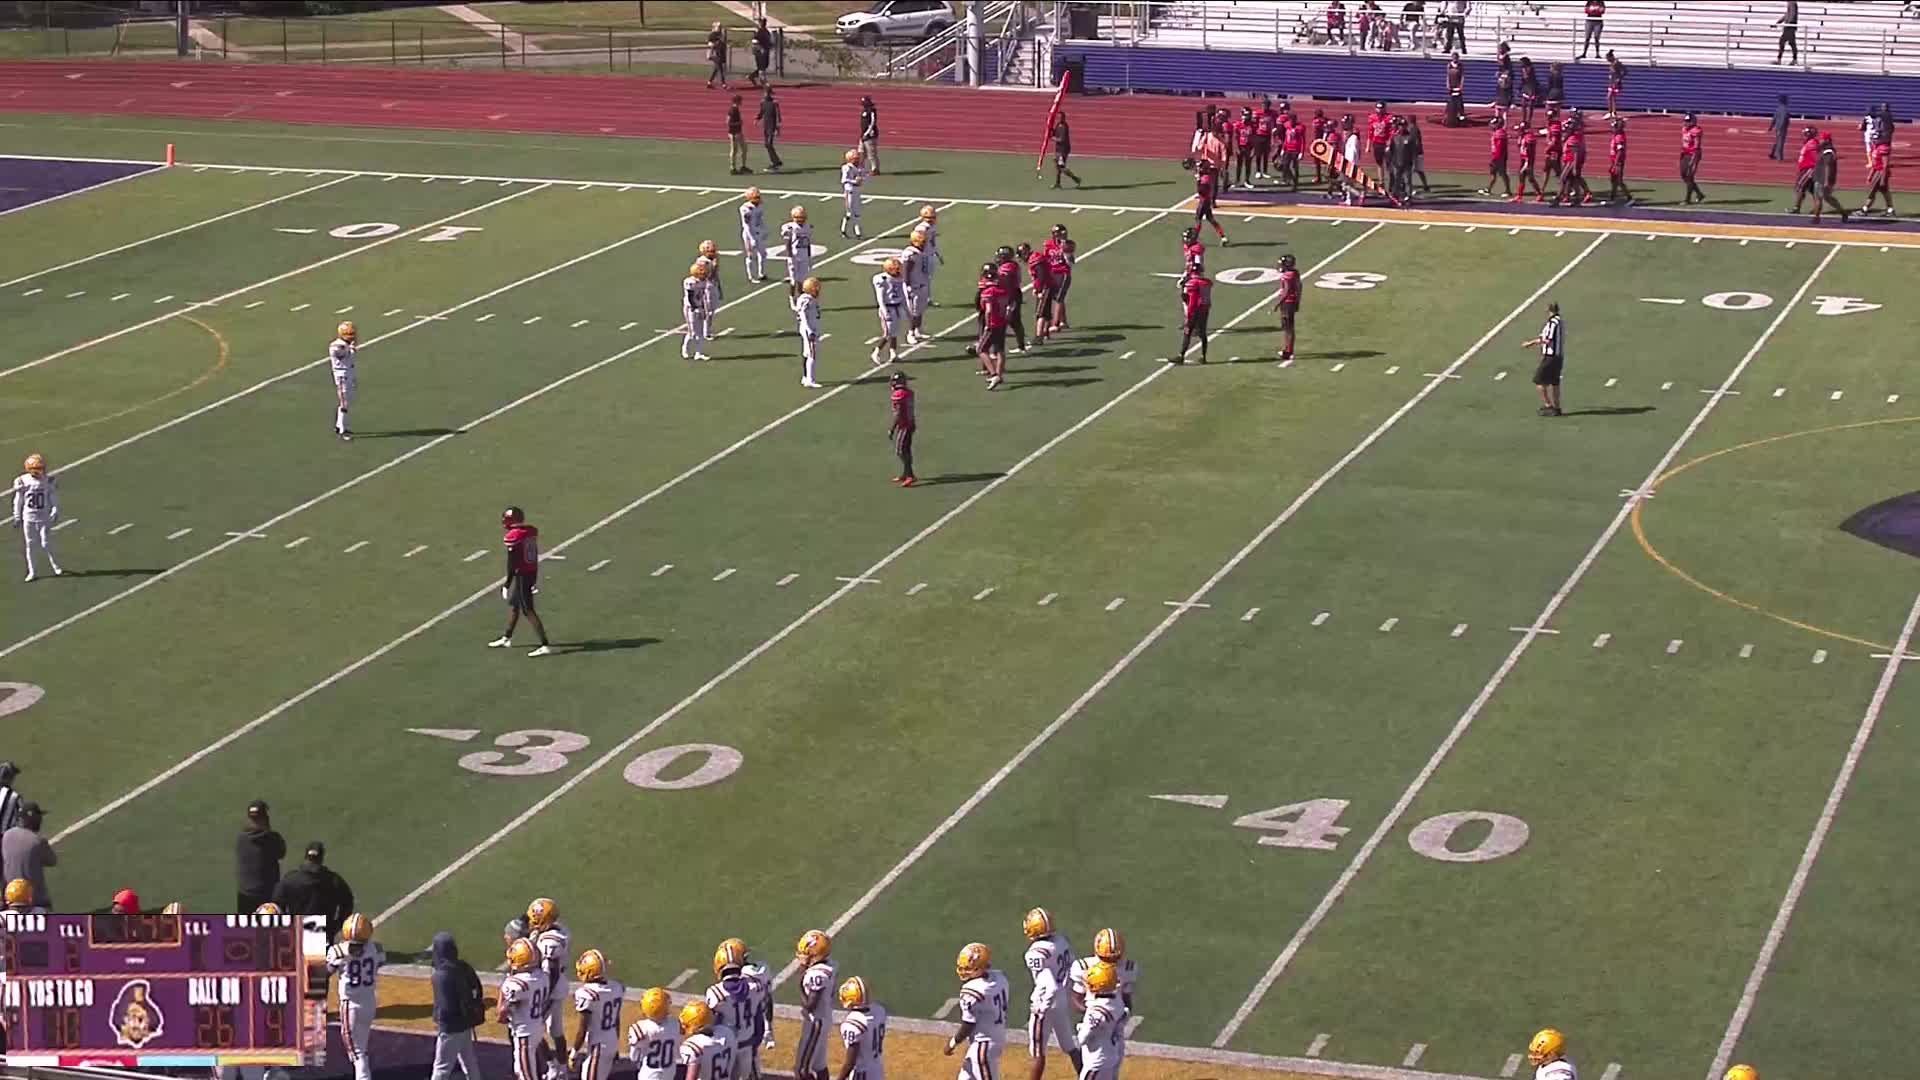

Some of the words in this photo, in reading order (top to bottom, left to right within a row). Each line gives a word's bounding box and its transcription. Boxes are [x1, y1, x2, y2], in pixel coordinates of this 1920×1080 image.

[27, 492, 44, 509] 30
[349, 957, 375, 988] 83
[647, 1039, 674, 1069] 20
